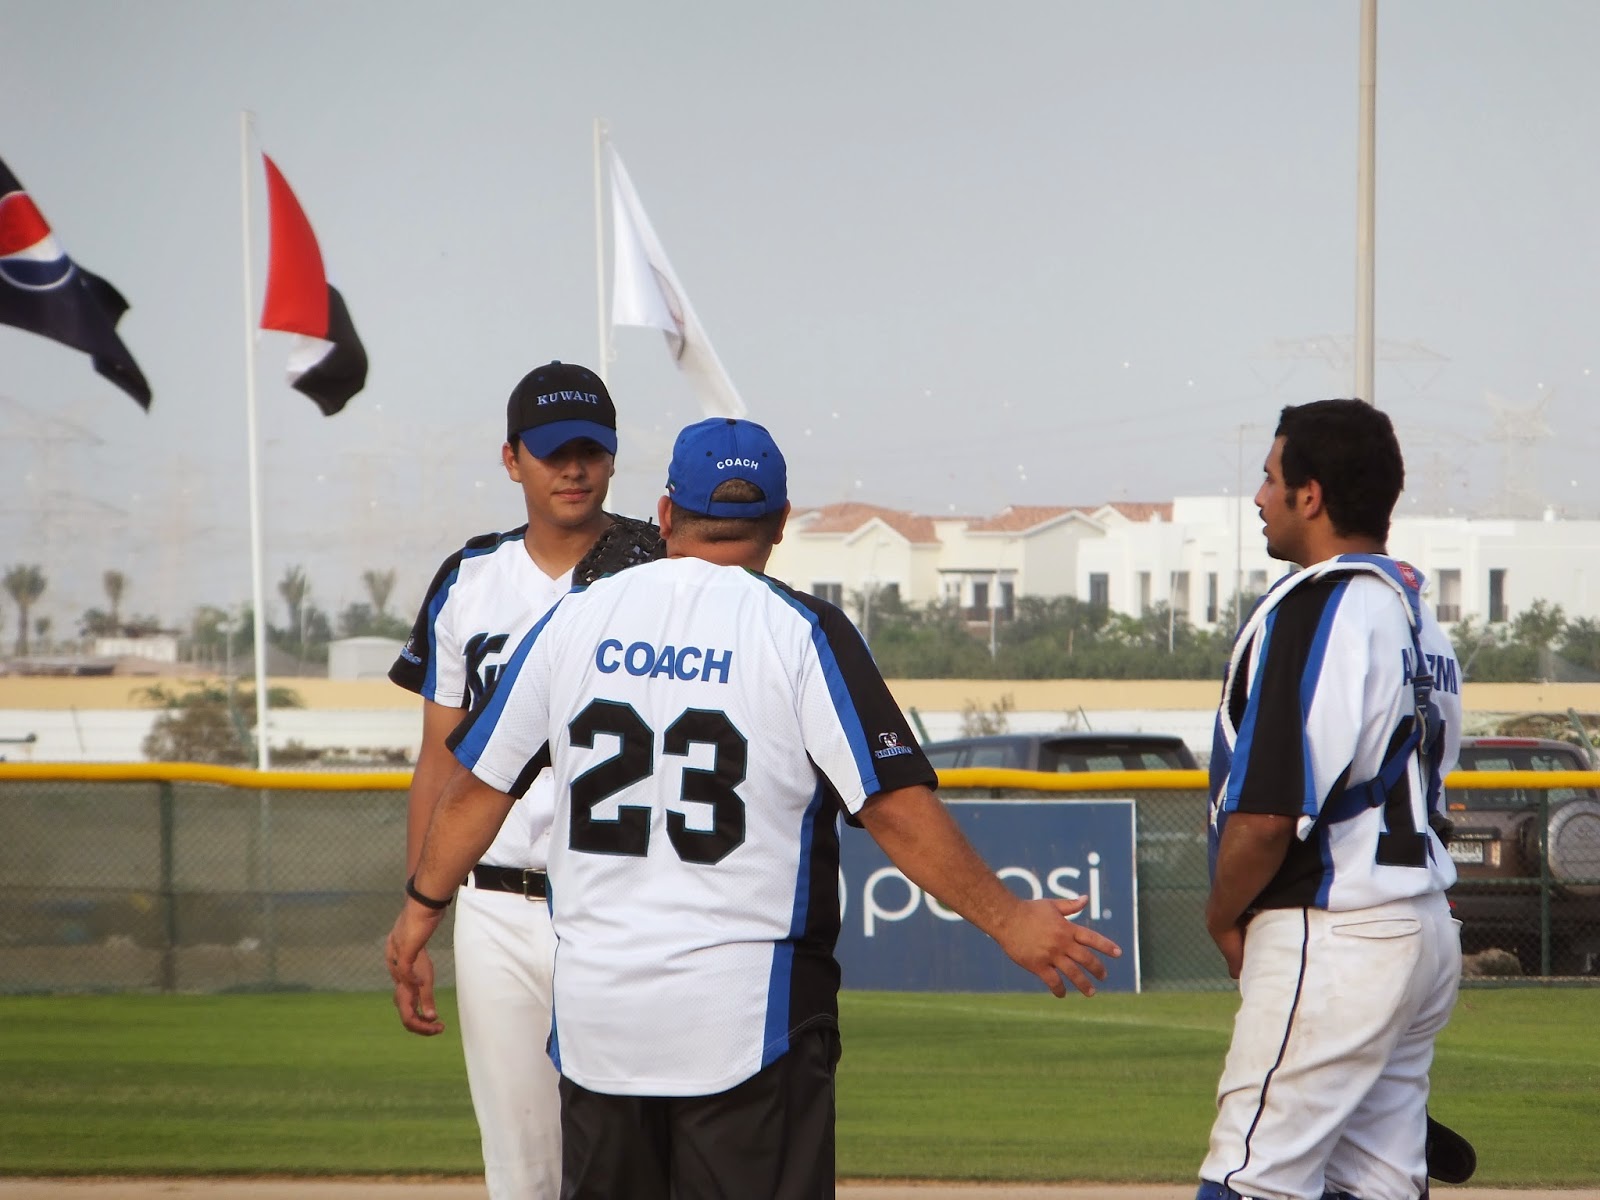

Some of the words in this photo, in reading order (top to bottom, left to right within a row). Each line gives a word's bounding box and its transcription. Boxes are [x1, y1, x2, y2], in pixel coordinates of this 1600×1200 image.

[536, 390, 598, 406] KUWAIT
[716, 457, 759, 470] COACH
[595, 638, 733, 684] COACH
[568, 697, 748, 866] 23
